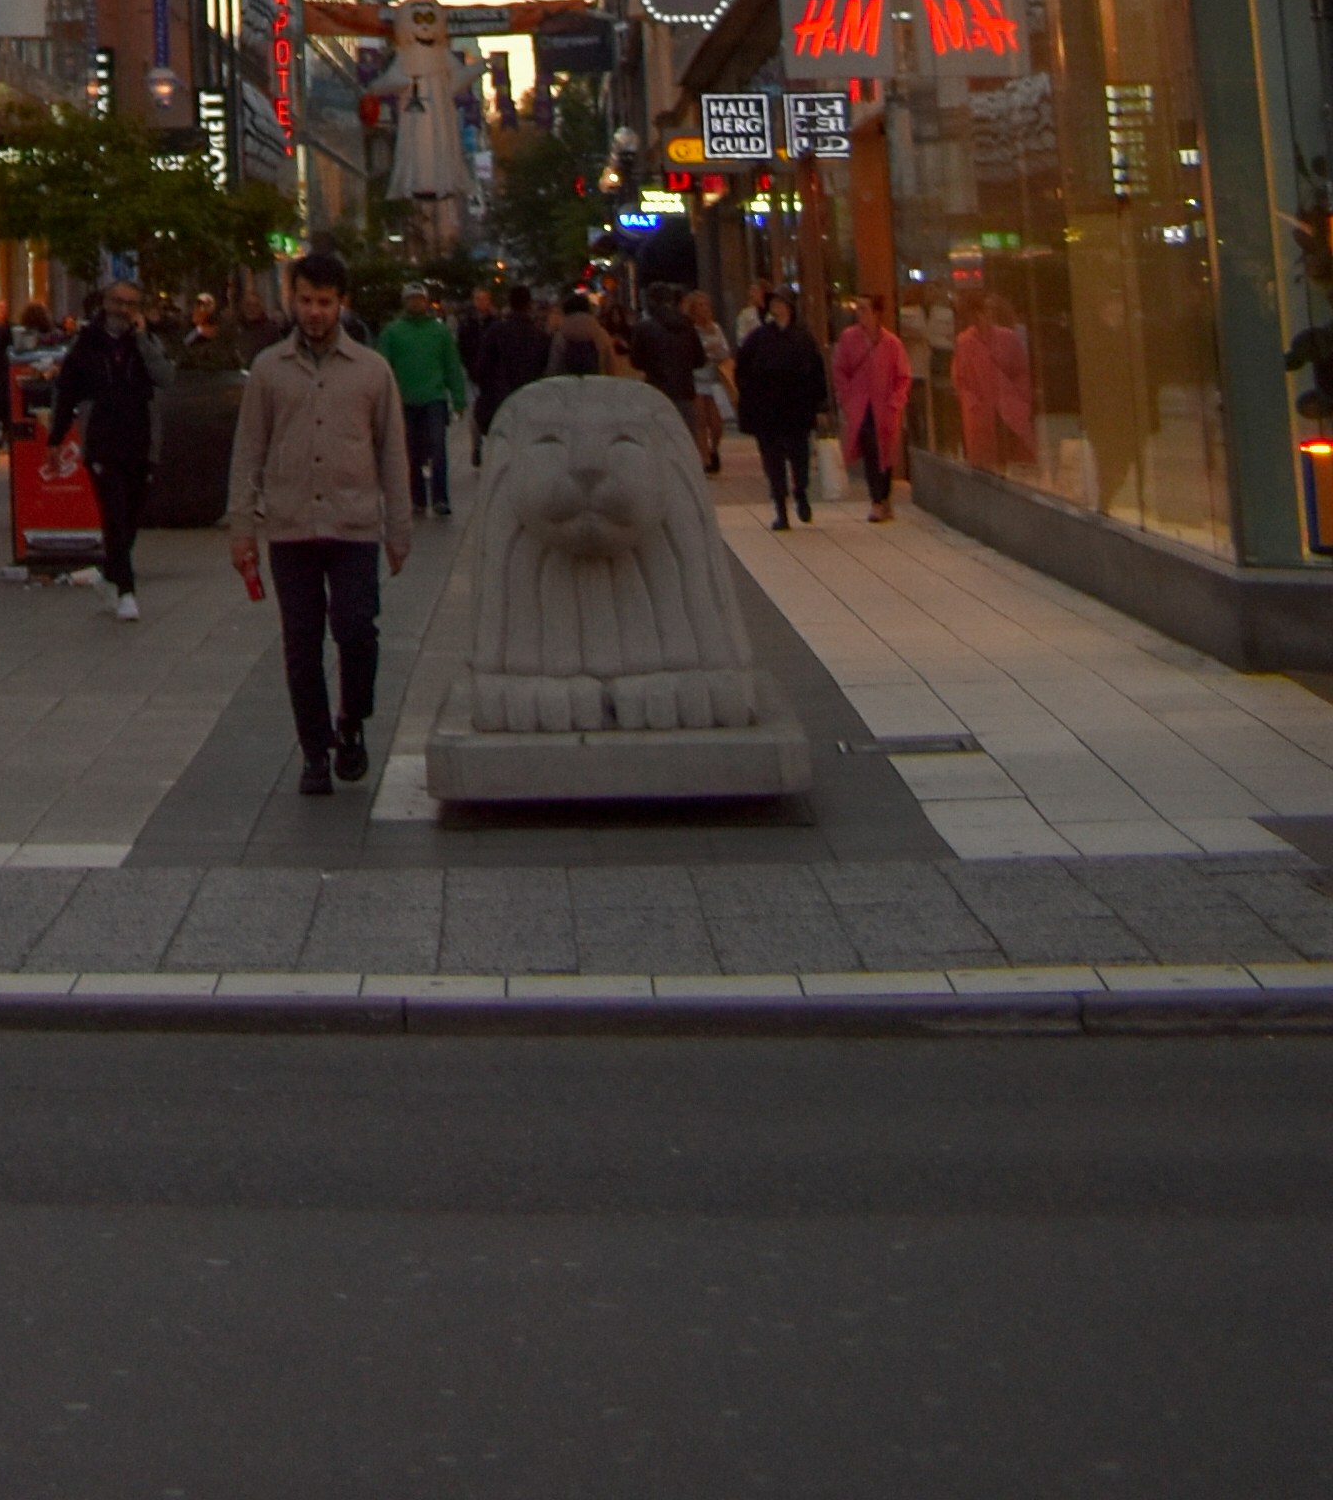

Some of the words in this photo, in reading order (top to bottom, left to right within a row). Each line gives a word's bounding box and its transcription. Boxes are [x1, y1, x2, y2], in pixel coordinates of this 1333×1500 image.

[709, 100, 761, 117] HALL
[710, 116, 763, 133] BERG
[710, 135, 766, 154] GULD
